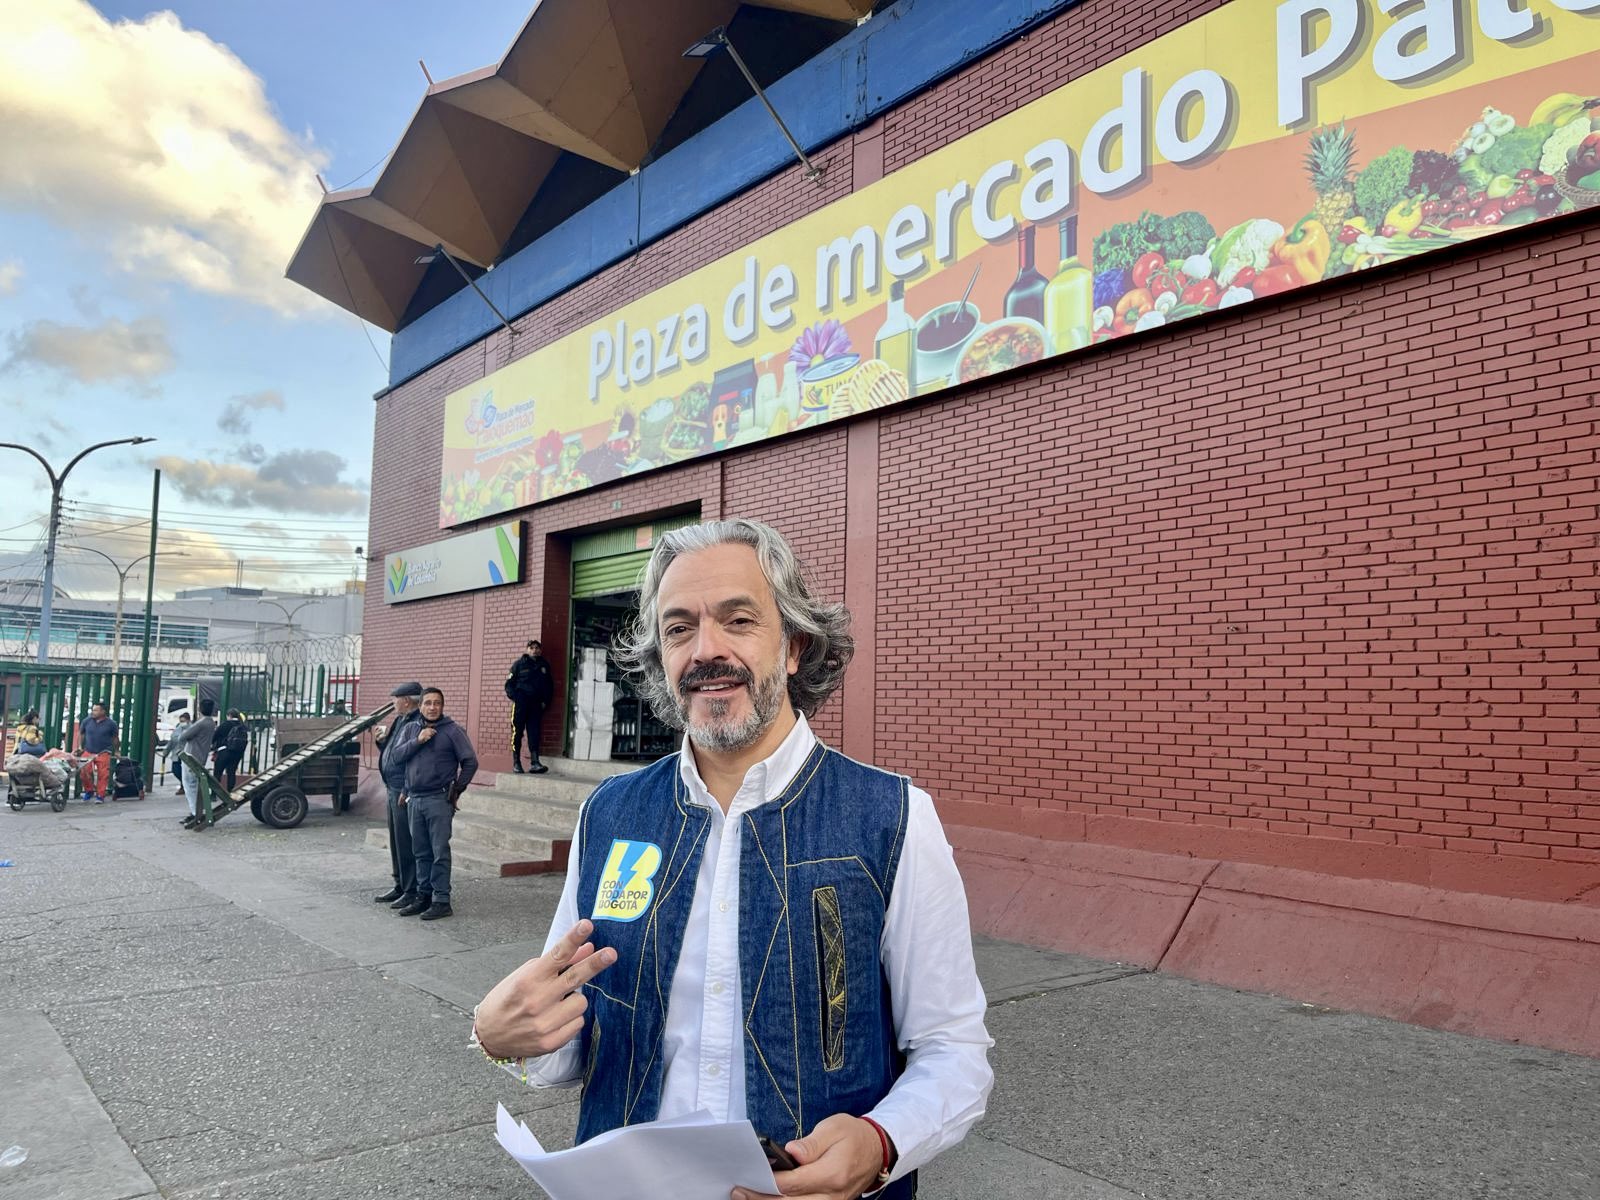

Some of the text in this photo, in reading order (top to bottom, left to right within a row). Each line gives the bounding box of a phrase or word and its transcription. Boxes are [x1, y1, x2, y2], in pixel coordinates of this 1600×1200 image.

[589, 303, 708, 400] Plaza
[723, 255, 796, 344] de
[816, 66, 1229, 309] mercado
[602, 880, 624, 890] CON
[601, 890, 648, 900] TODA POR
